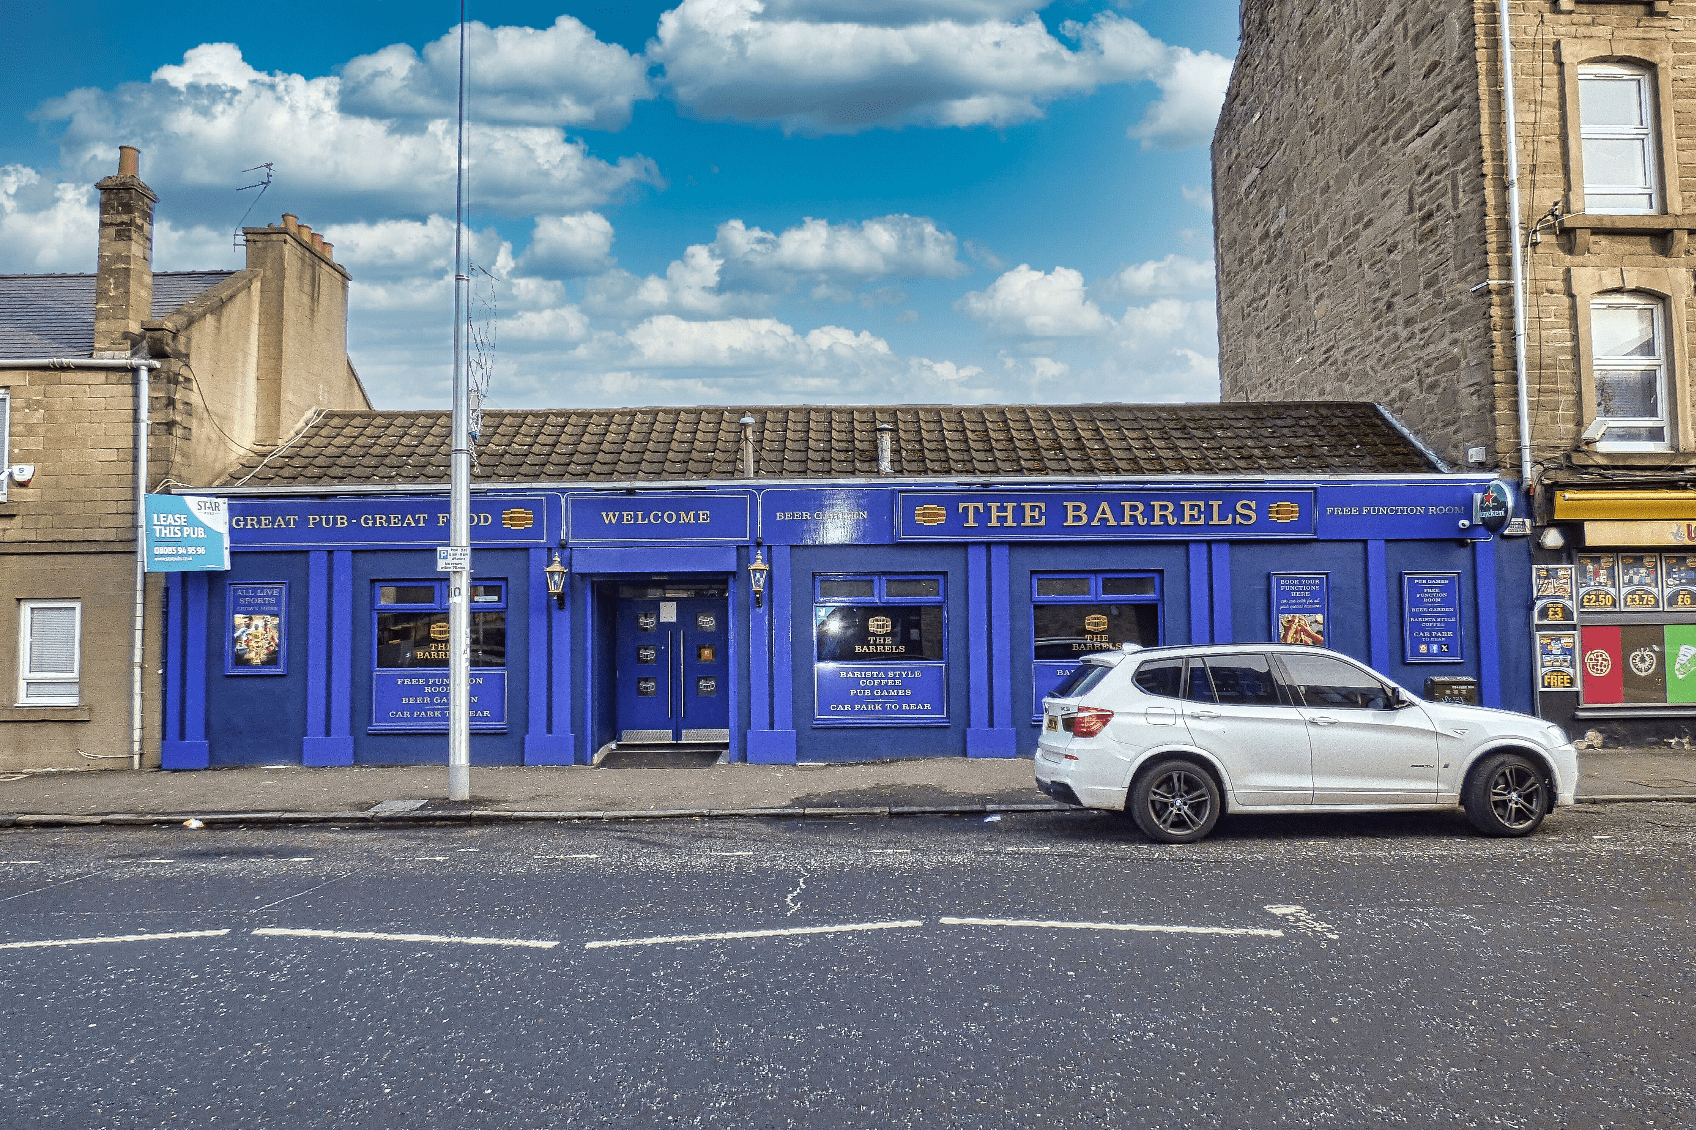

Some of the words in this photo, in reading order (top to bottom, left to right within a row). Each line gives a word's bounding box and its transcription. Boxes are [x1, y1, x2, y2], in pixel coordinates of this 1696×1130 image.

[197, 500, 221, 511] STAR
[1326, 507, 1359, 515] FREE
[1362, 506, 1425, 515] FUNCTION
[1428, 506, 1465, 515] ROOM
[601, 510, 710, 524] WELCOME
[776, 511, 811, 520] BEER
[958, 502, 1047, 527] THE
[1063, 500, 1258, 527] BARRELS
[153, 513, 188, 526] LEASE
[232, 515, 298, 529] GREAT
[438, 513, 492, 526] FOD
[153, 526, 181, 538] THIS
[183, 527, 208, 539] PUB.
[257, 588, 280, 596] LIVE
[1583, 594, 1613, 606] £2.50
[1626, 594, 1655, 606] £3.75
[1677, 594, 1691, 606] £6
[1548, 607, 1563, 618] £3
[868, 636, 892, 644] THE
[1085, 634, 1109, 642] THE
[855, 645, 906, 653] BARRELS
[1072, 642, 1122, 651] BARRELS
[888, 670, 922, 678] STYLE
[1544, 675, 1571, 687] FREE
[402, 696, 431, 704] BEER
[854, 703, 883, 711] PARK
